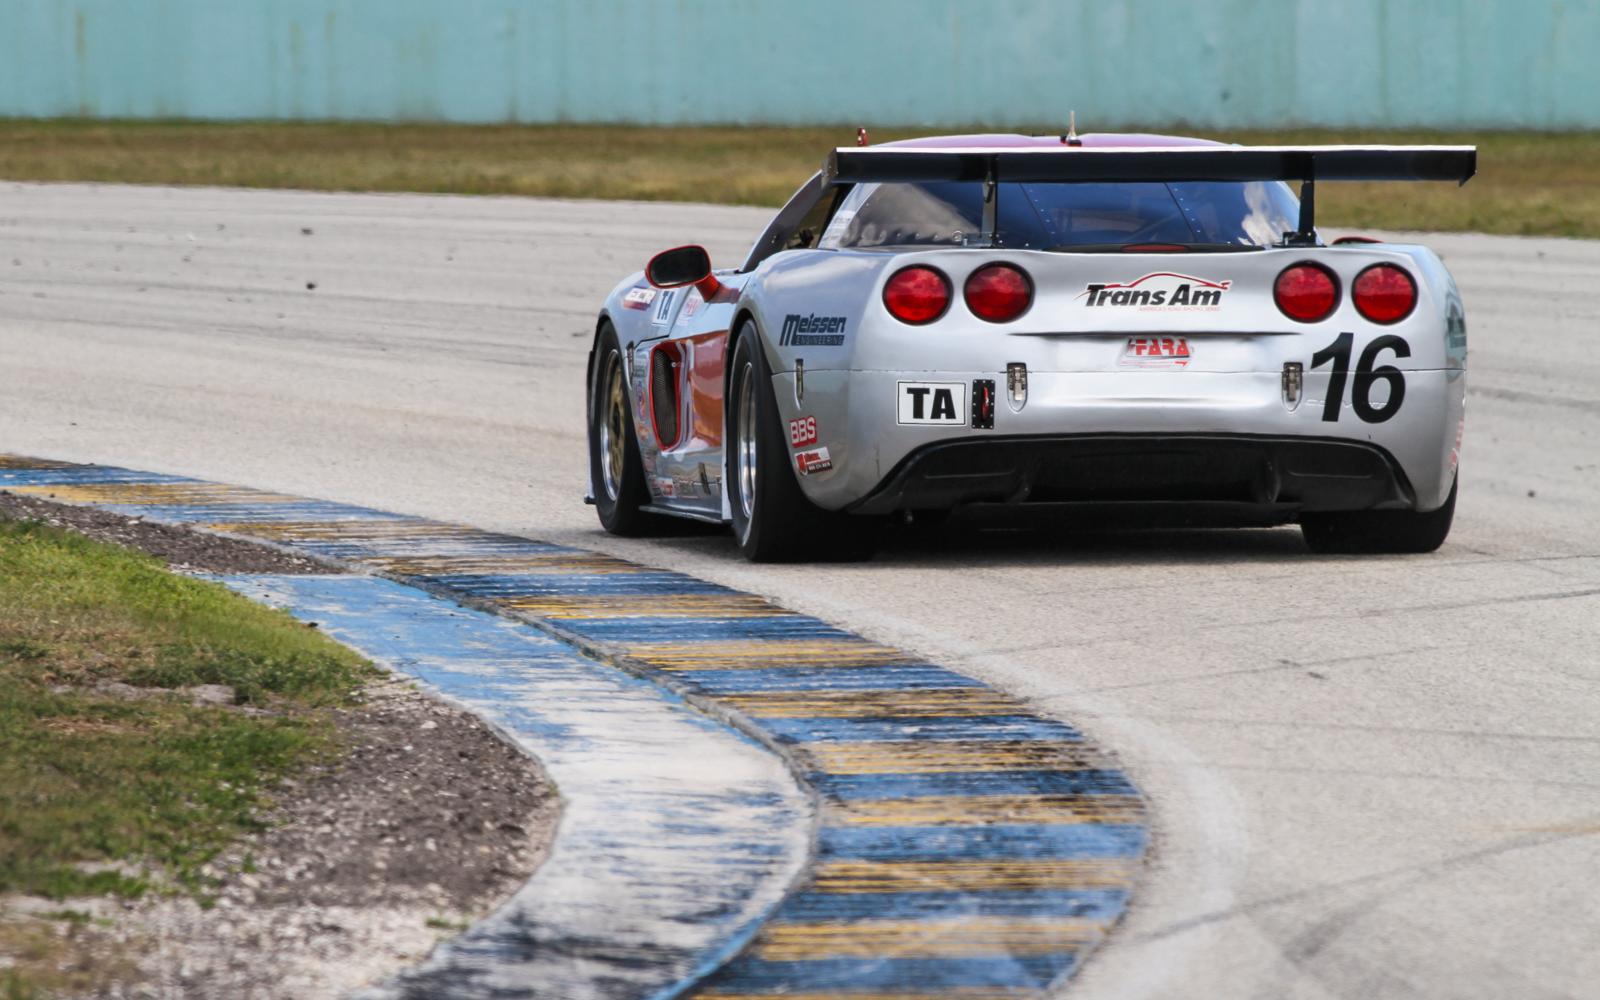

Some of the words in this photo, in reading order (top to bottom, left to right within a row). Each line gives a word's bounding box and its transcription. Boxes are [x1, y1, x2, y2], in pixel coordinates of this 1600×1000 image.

[657, 290, 676, 320] TA
[1085, 284, 1167, 307] Trans
[1168, 284, 1222, 306] Am
[779, 312, 847, 346] Meissen
[1135, 338, 1190, 356] FARA
[1310, 332, 1412, 424] 16
[906, 387, 957, 420] TA
[790, 416, 816, 443] BBS
